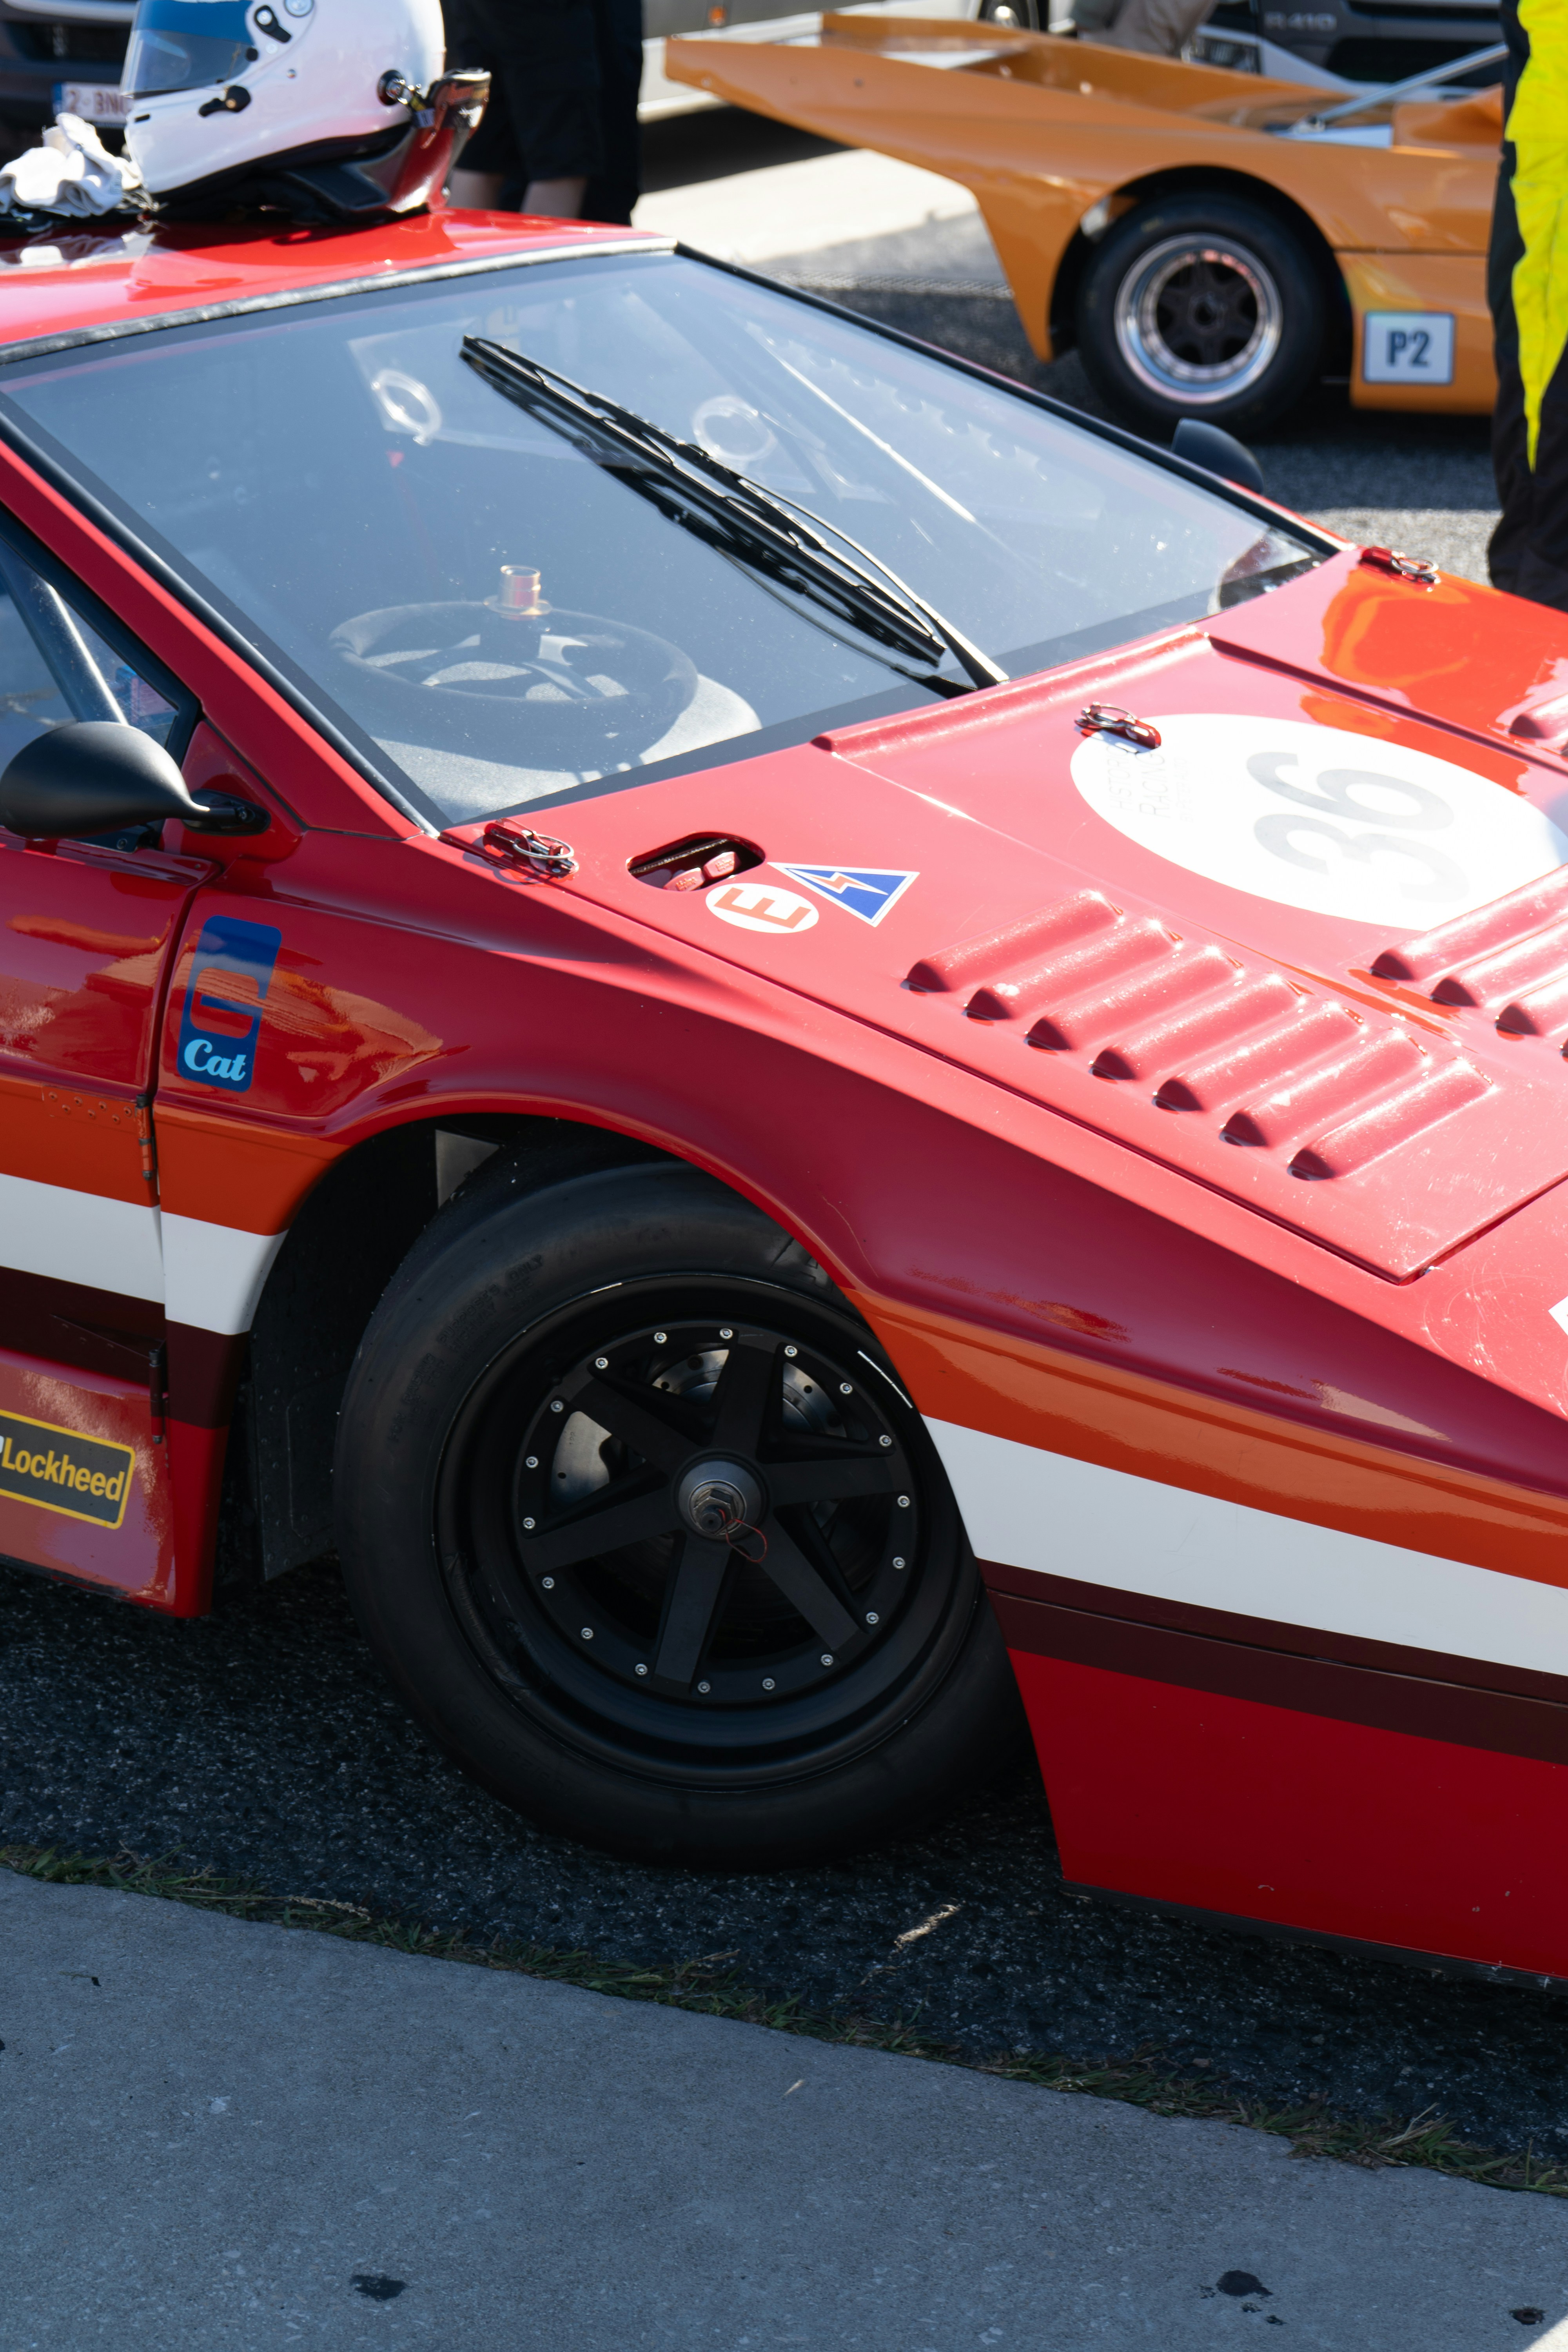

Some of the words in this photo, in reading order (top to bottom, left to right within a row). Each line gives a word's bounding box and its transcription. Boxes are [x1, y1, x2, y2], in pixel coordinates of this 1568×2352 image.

[1389, 330, 1429, 365] P2
[1136, 753, 1172, 818] RACING
[1247, 751, 1470, 903] 36
[713, 887, 811, 929] E
[184, 1039, 247, 1081] Cat
[387, 1412, 407, 1443] FOR
[402, 1353, 438, 1406] RACING
[437, 1284, 501, 1346] PURPOSES
[508, 1254, 544, 1282] ONLY
[449, 1302, 498, 1355] HIGHWAY
[504, 1277, 534, 1300] USE
[1, 1437, 125, 1502] Lockheed
